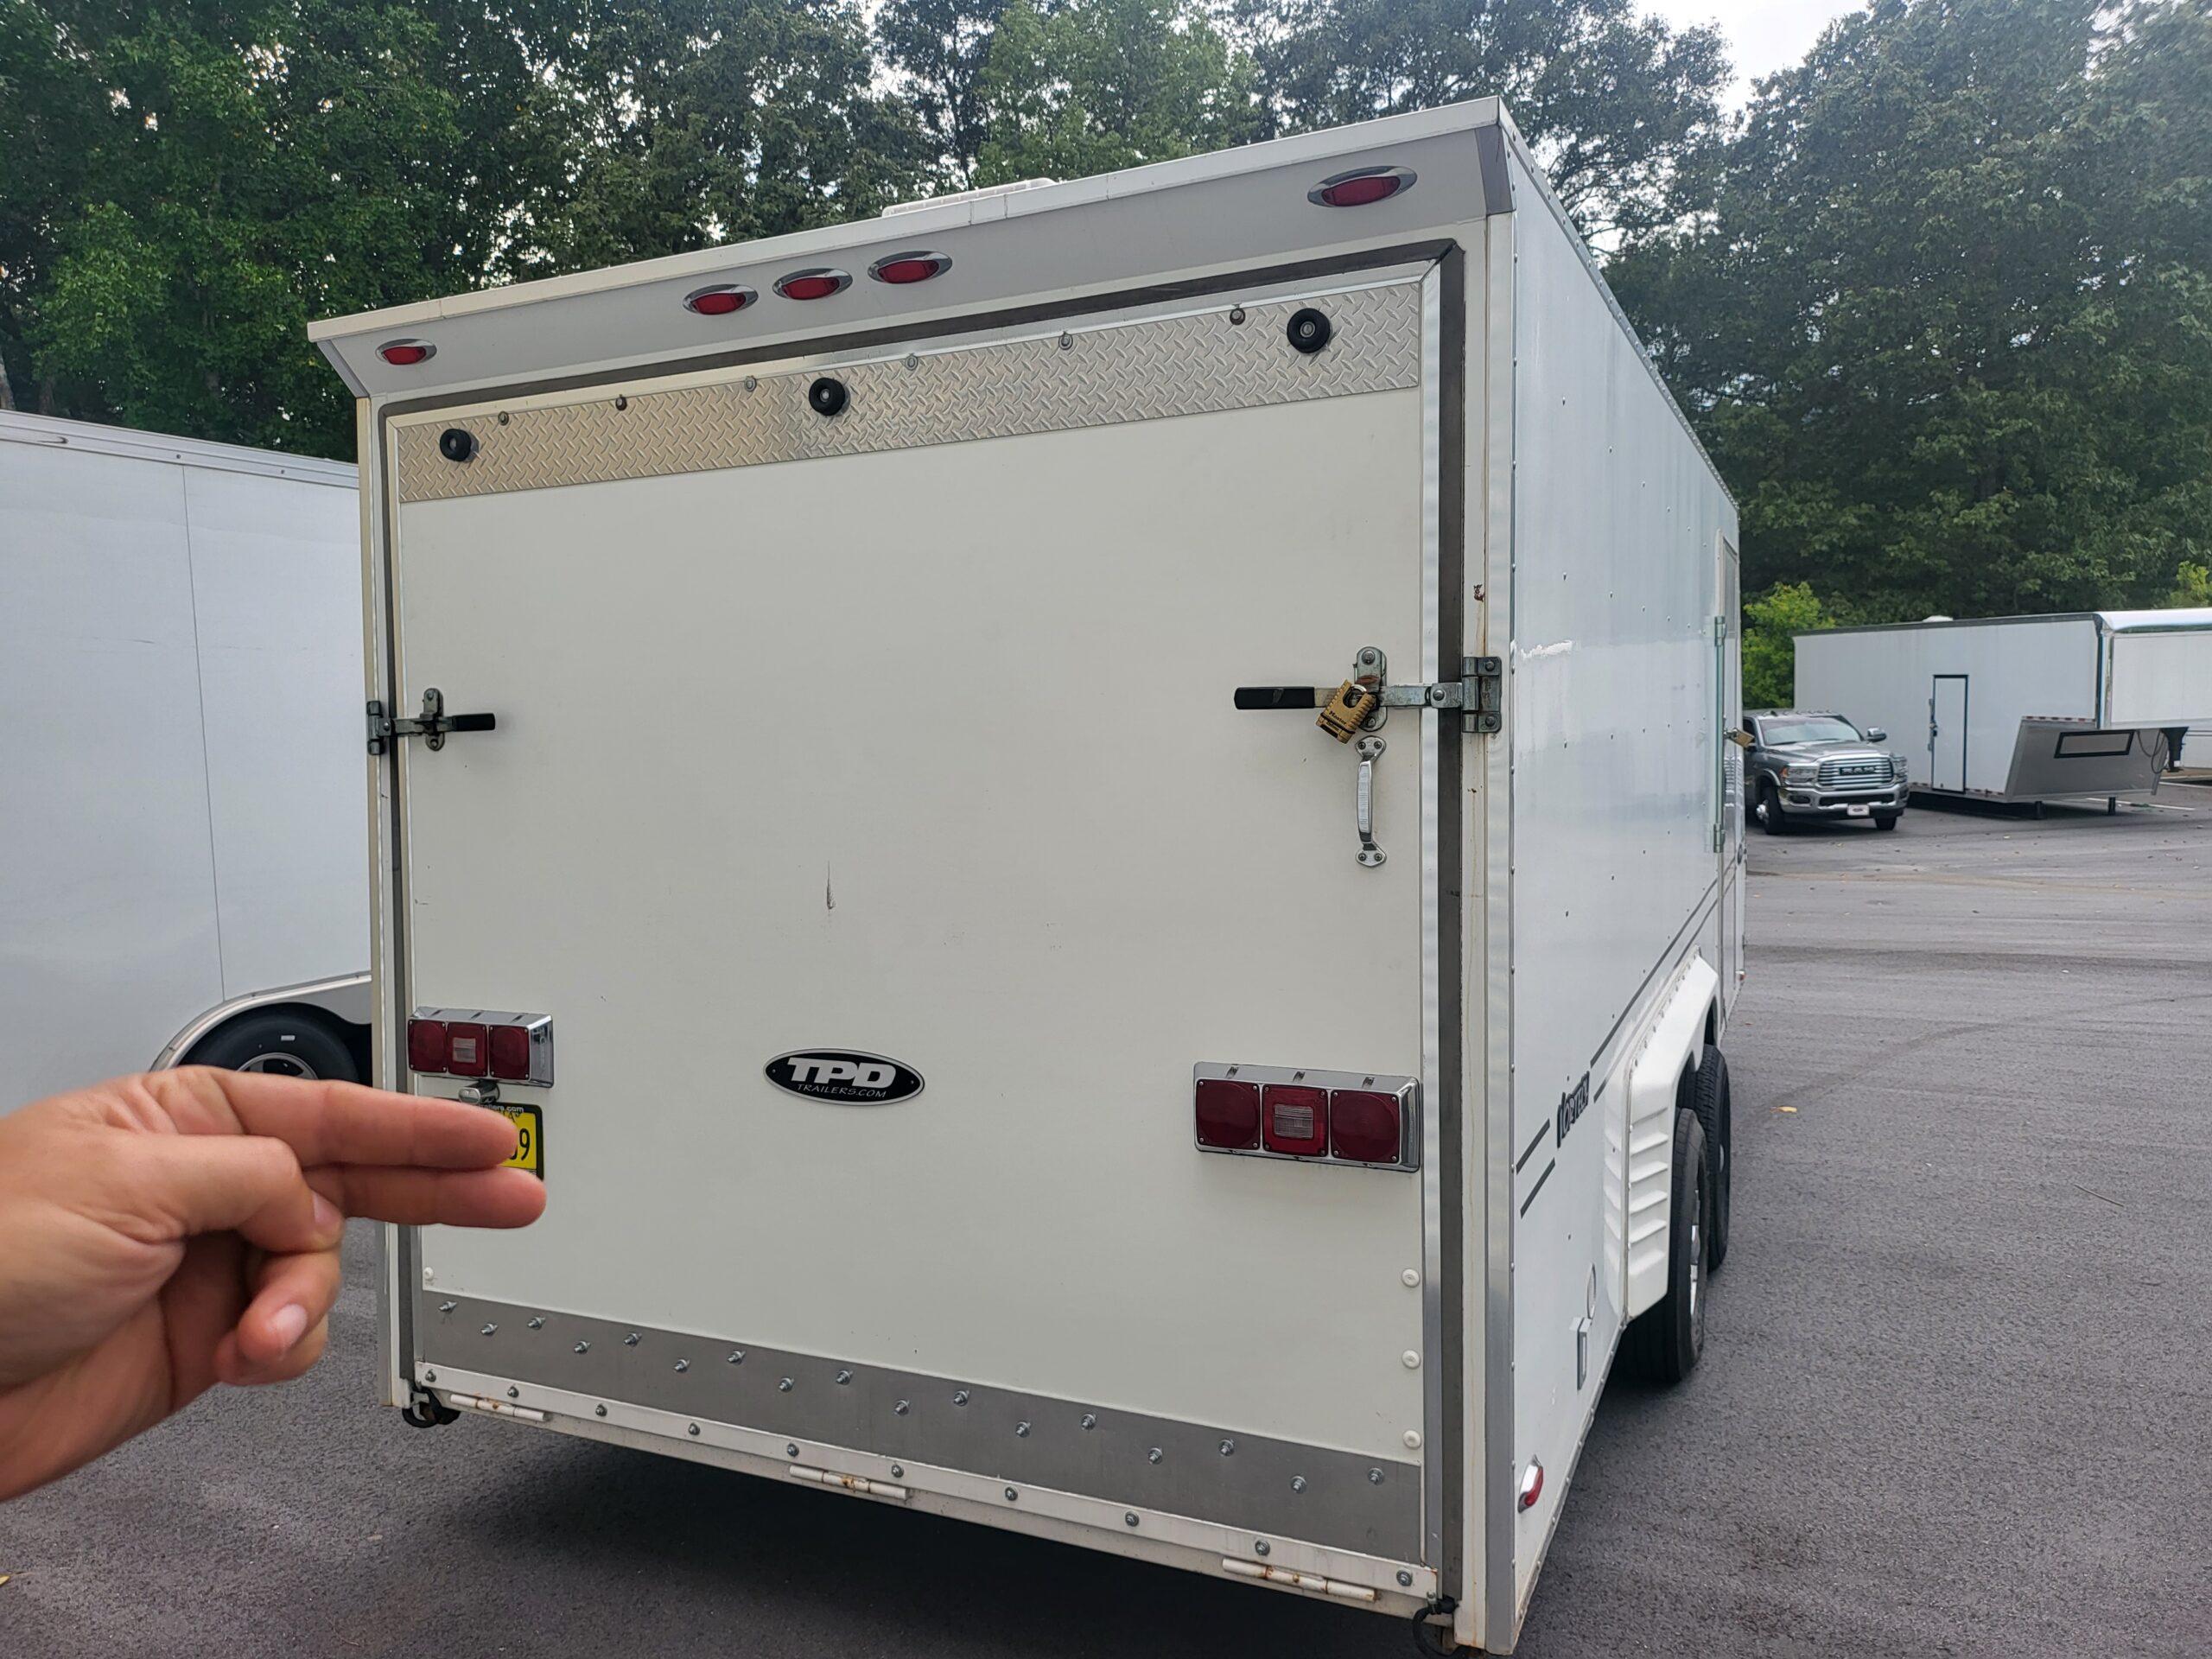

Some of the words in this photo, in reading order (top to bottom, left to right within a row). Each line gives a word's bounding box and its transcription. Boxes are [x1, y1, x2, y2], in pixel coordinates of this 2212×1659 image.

[1328, 710, 1347, 725] Master
[1840, 766, 1876, 775] RAM
[786, 1057, 897, 1089] TPD
[796, 1083, 887, 1098] TRAILERS.COM
